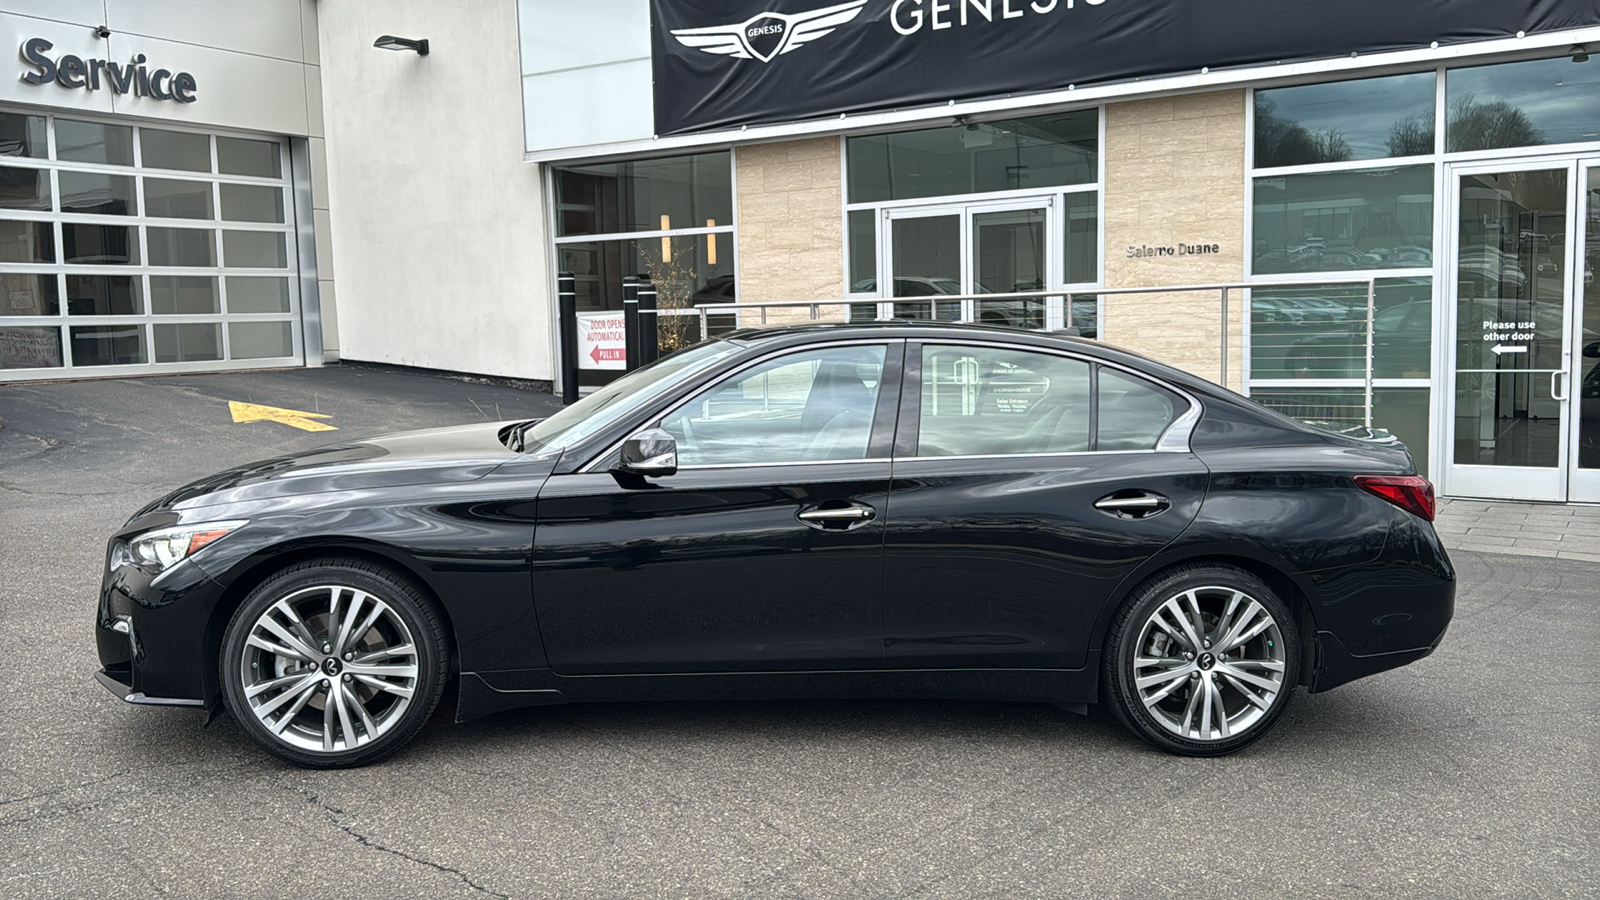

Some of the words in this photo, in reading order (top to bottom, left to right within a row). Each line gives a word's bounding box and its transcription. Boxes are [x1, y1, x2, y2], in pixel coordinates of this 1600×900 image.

[748, 24, 783, 37] GENESIS
[22, 37, 197, 104] Service
[1126, 245, 1175, 258] Salerno
[1178, 243, 1220, 256] Duane
[590, 320, 606, 330] DOOR
[1483, 321, 1516, 329] Please
[1518, 321, 1536, 329] use
[587, 331, 625, 341] AUTOMATICAL
[1483, 332, 1510, 340] other
[1511, 332, 1535, 340] door
[600, 350, 613, 359] PULL
[613, 350, 620, 359] IN
